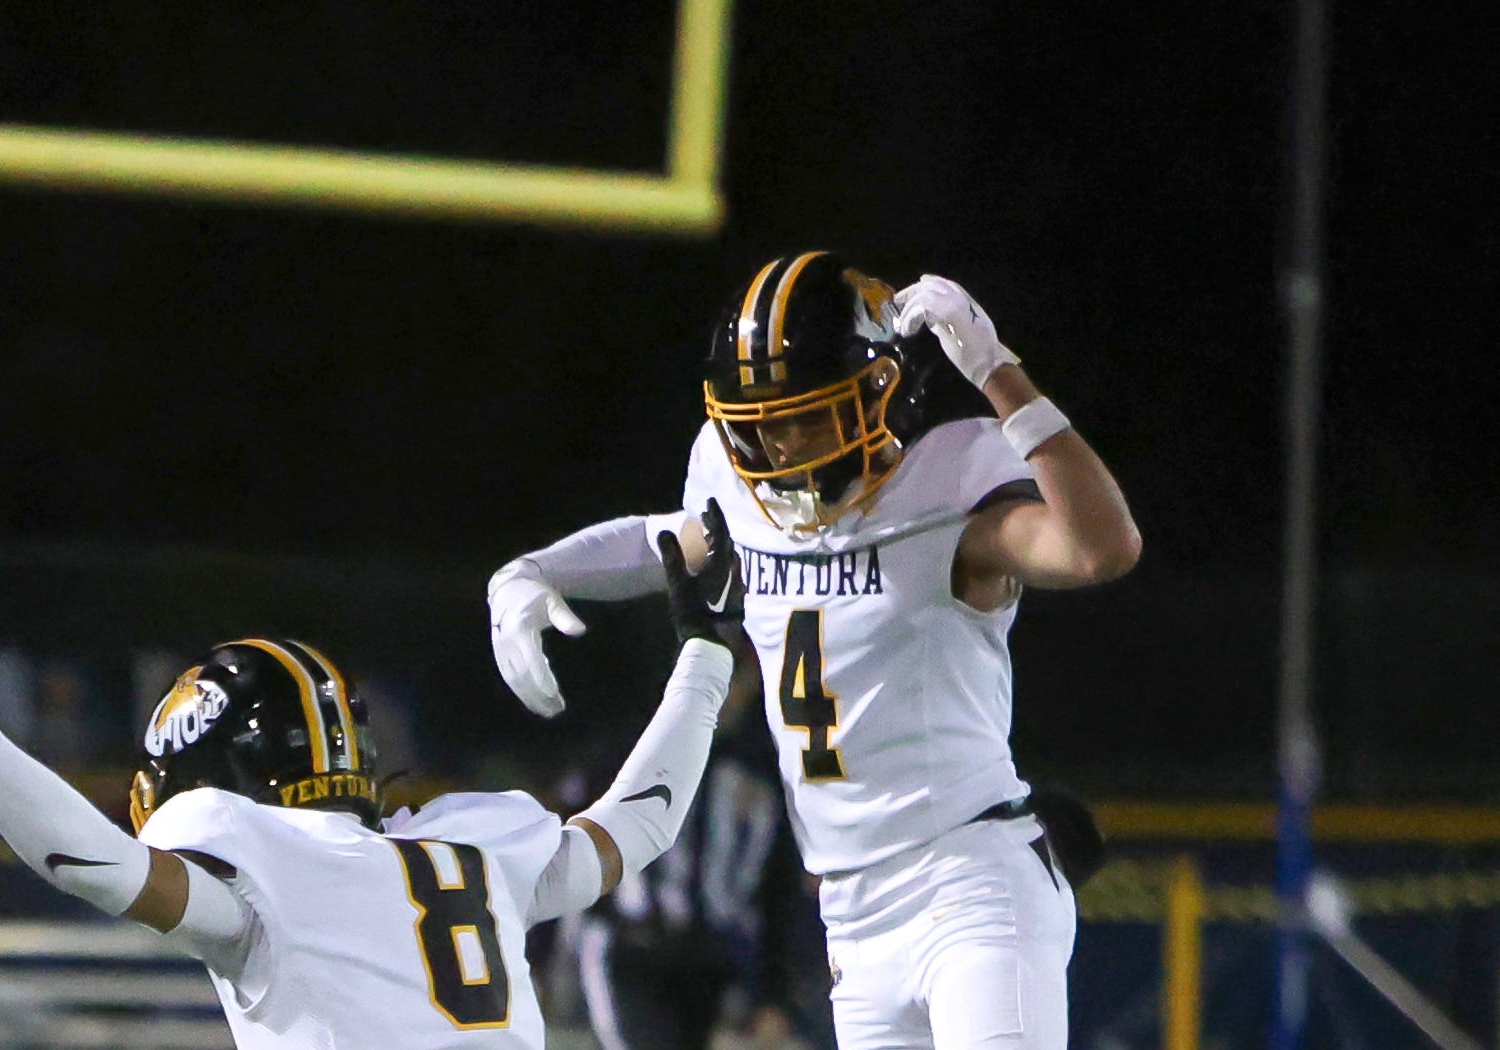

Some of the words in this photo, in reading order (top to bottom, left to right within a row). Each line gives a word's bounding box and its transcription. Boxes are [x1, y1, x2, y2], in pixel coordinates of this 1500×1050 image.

[742, 544, 883, 596] VENTURA
[778, 607, 849, 783] 4
[386, 836, 514, 1031] 8
